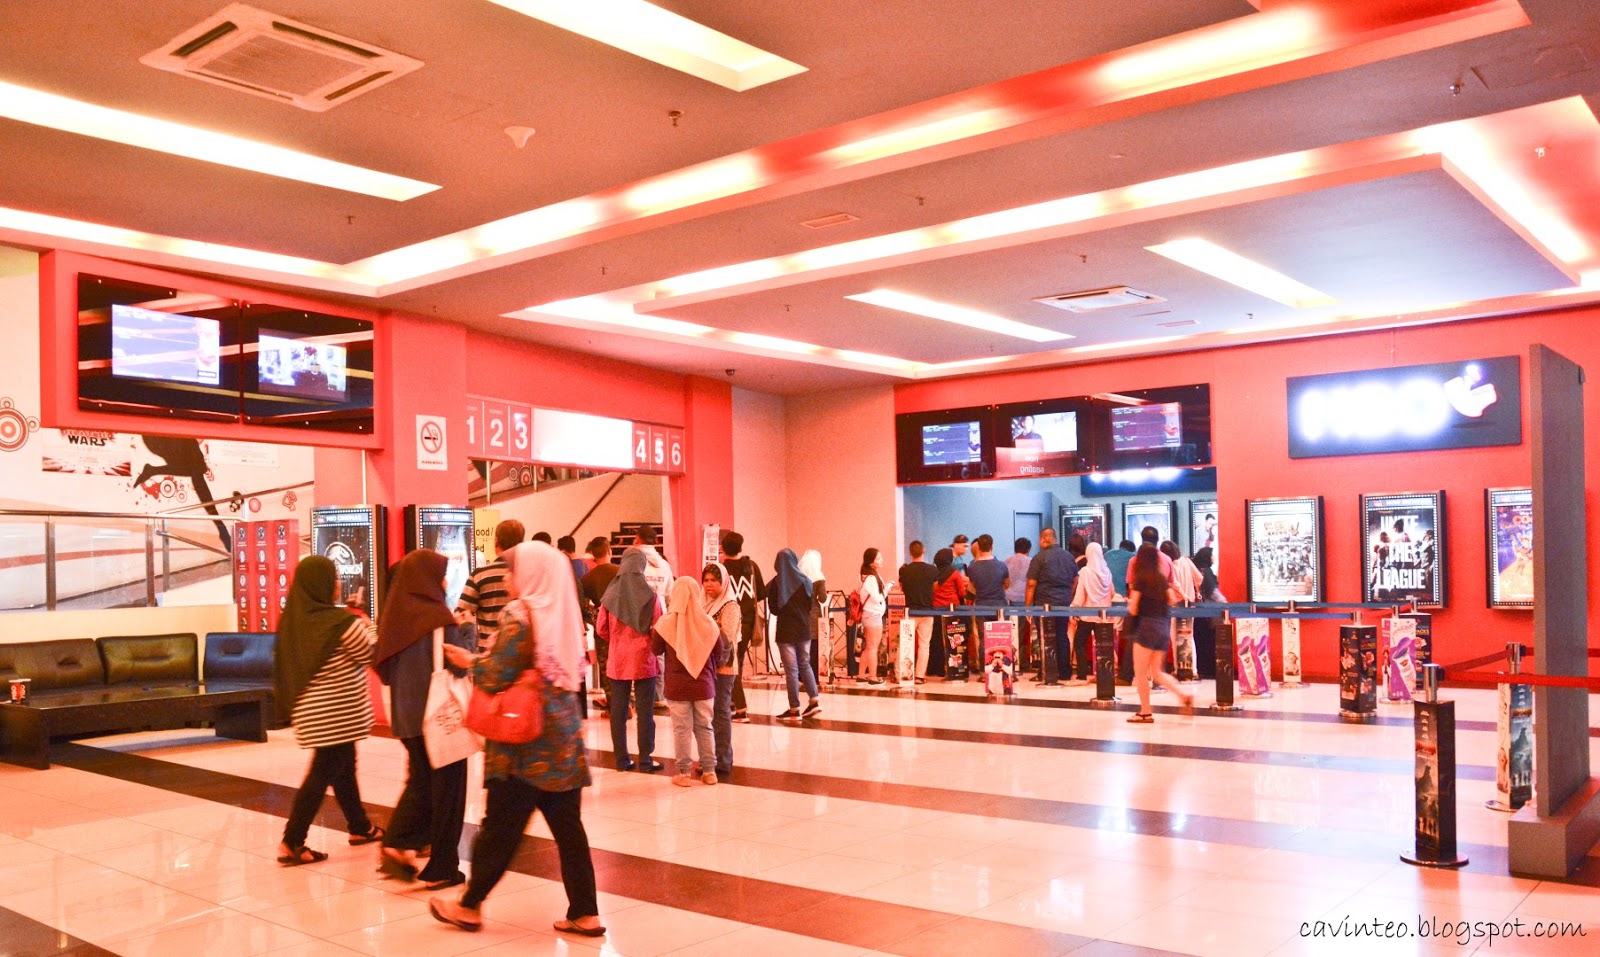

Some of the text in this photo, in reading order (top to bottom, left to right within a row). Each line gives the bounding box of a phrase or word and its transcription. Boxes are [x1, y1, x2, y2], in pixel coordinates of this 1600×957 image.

[68, 434, 108, 447] WARS
[466, 415, 475, 444] 1
[490, 418, 504, 448] 2
[515, 421, 528, 450] 3
[635, 438, 647, 463] 4
[654, 439, 664, 465] 5
[671, 442, 682, 466] 6
[1380, 515, 1419, 534] UNTE
[1375, 568, 1426, 590] LEAGUE
